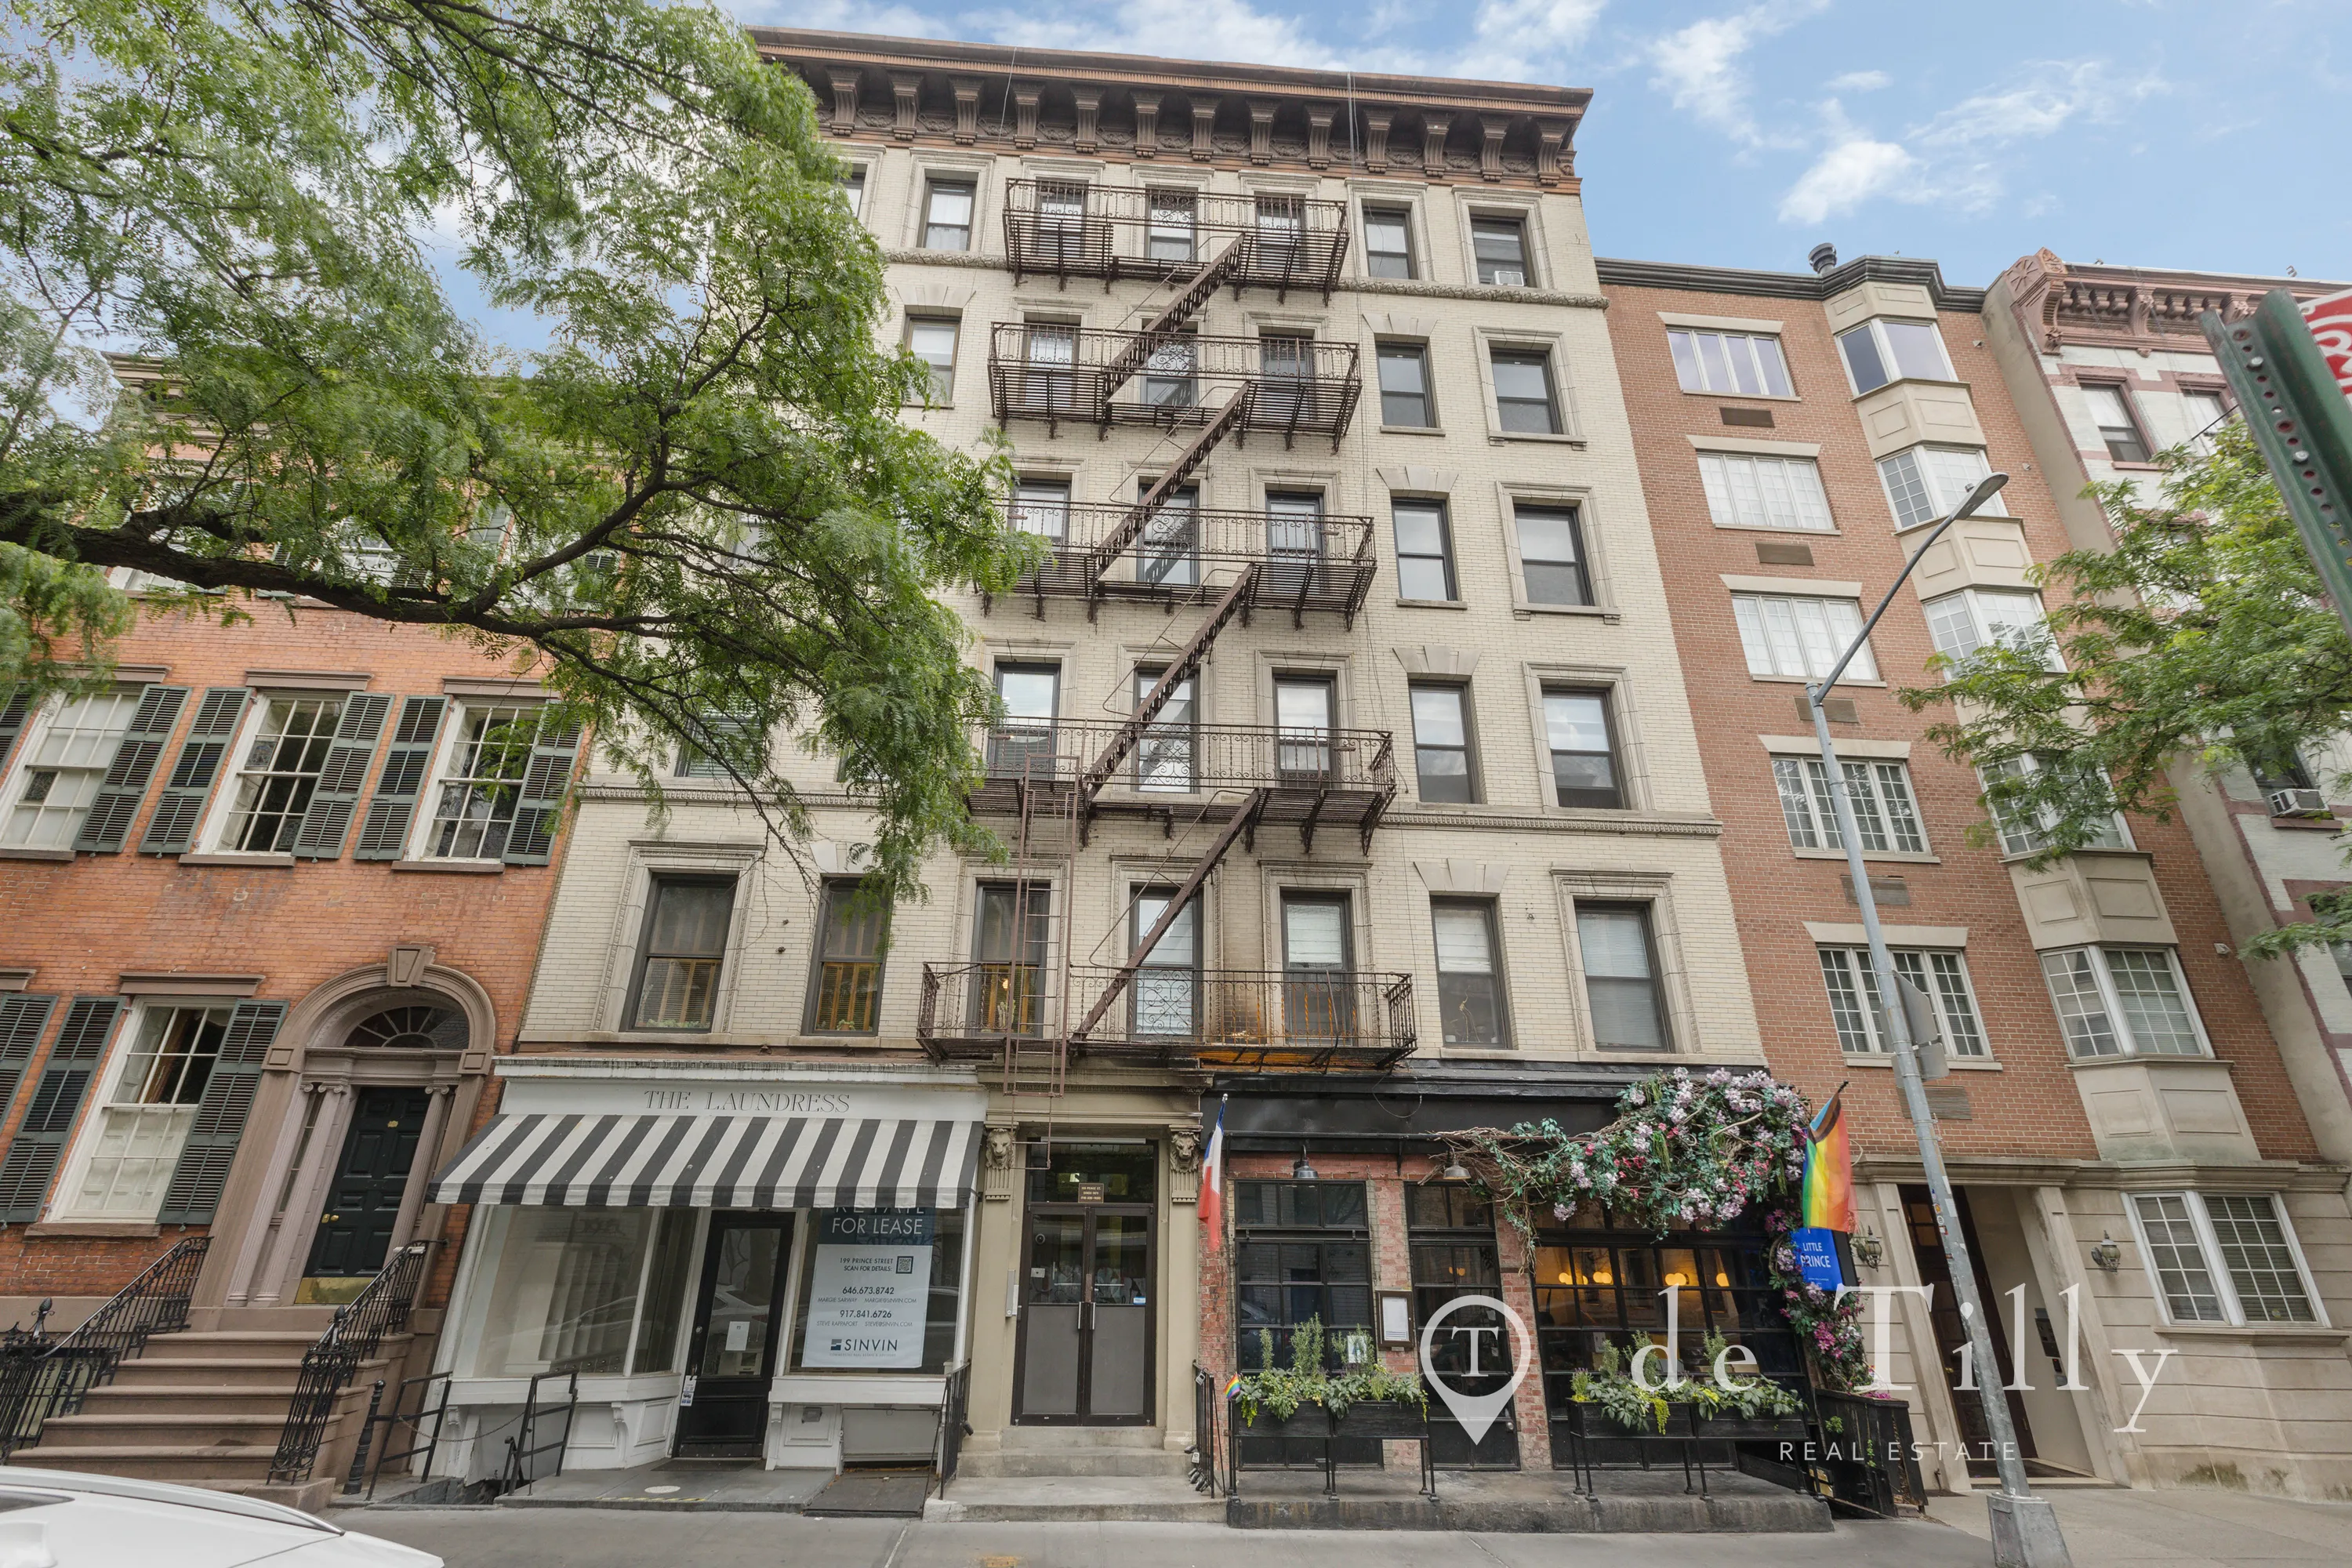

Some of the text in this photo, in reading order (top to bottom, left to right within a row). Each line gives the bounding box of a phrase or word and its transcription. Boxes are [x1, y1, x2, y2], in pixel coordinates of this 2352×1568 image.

[644, 1091, 851, 1113] THE LAUNDRESS
[832, 1218, 924, 1235] FOR LEASE
[1802, 1242, 1823, 1251] LITTLE
[1800, 1254, 1831, 1268] PRINCE
[844, 1339, 898, 1352] SINVIN
